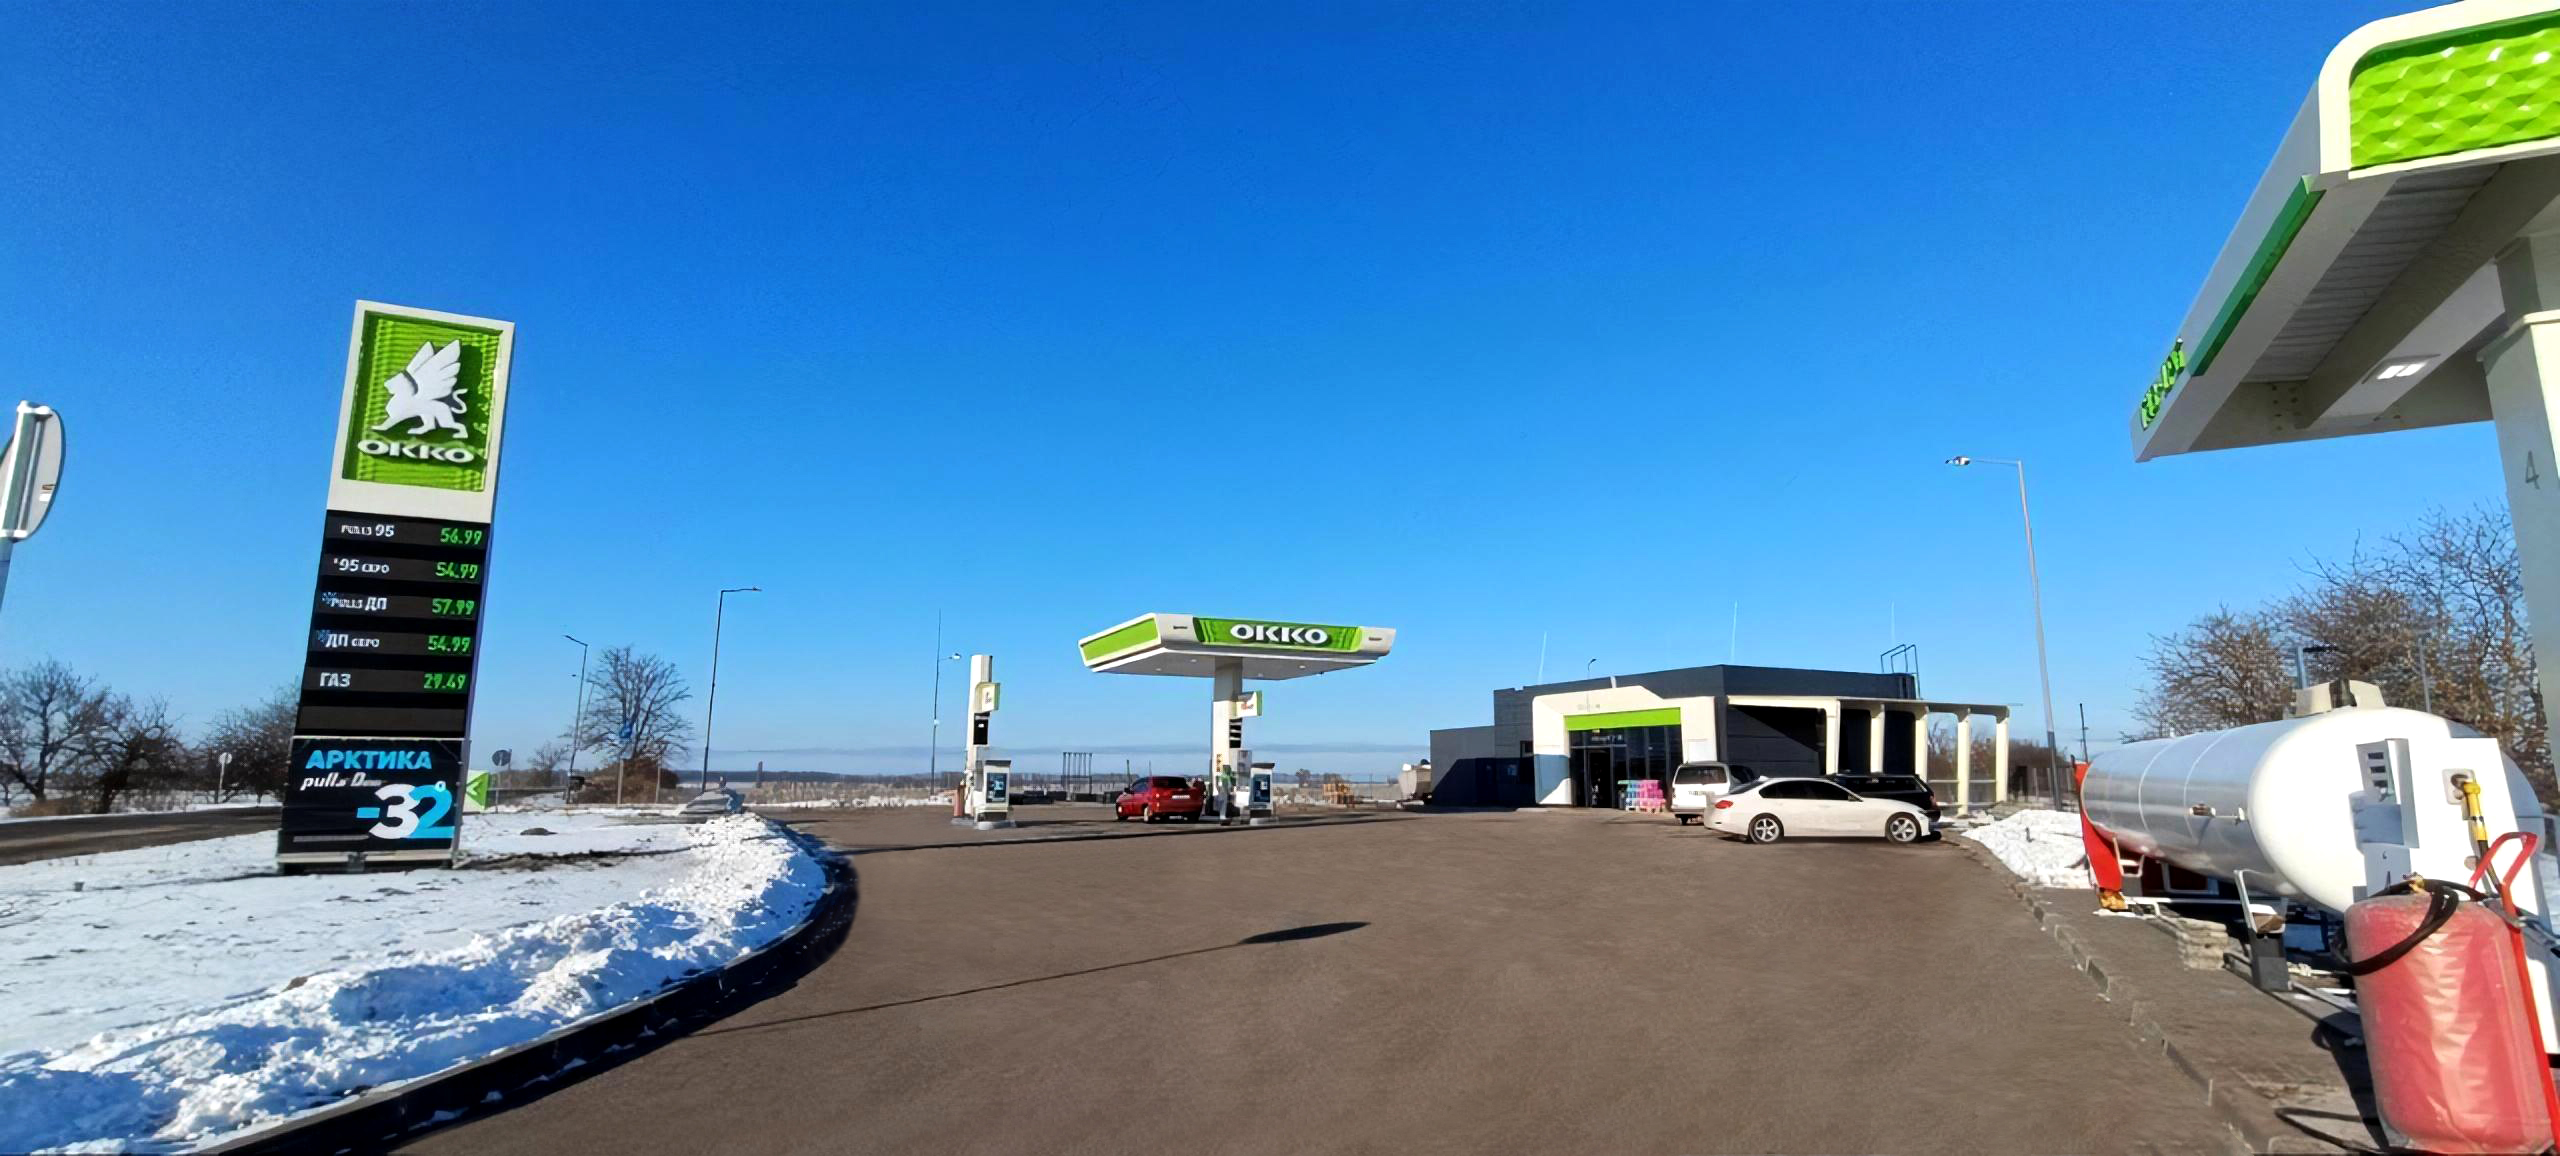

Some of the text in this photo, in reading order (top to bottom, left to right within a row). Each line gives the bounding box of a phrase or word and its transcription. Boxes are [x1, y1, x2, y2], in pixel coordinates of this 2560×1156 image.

[357, 439, 474, 462] OKKO
[375, 523, 395, 537] 95
[440, 527, 482, 544] 56.99
[365, 596, 388, 611] ДП
[431, 598, 475, 615] 57.99
[1230, 623, 1328, 644] OKKO
[319, 672, 351, 687] ГАЗ
[305, 750, 432, 770] АРКТИКА
